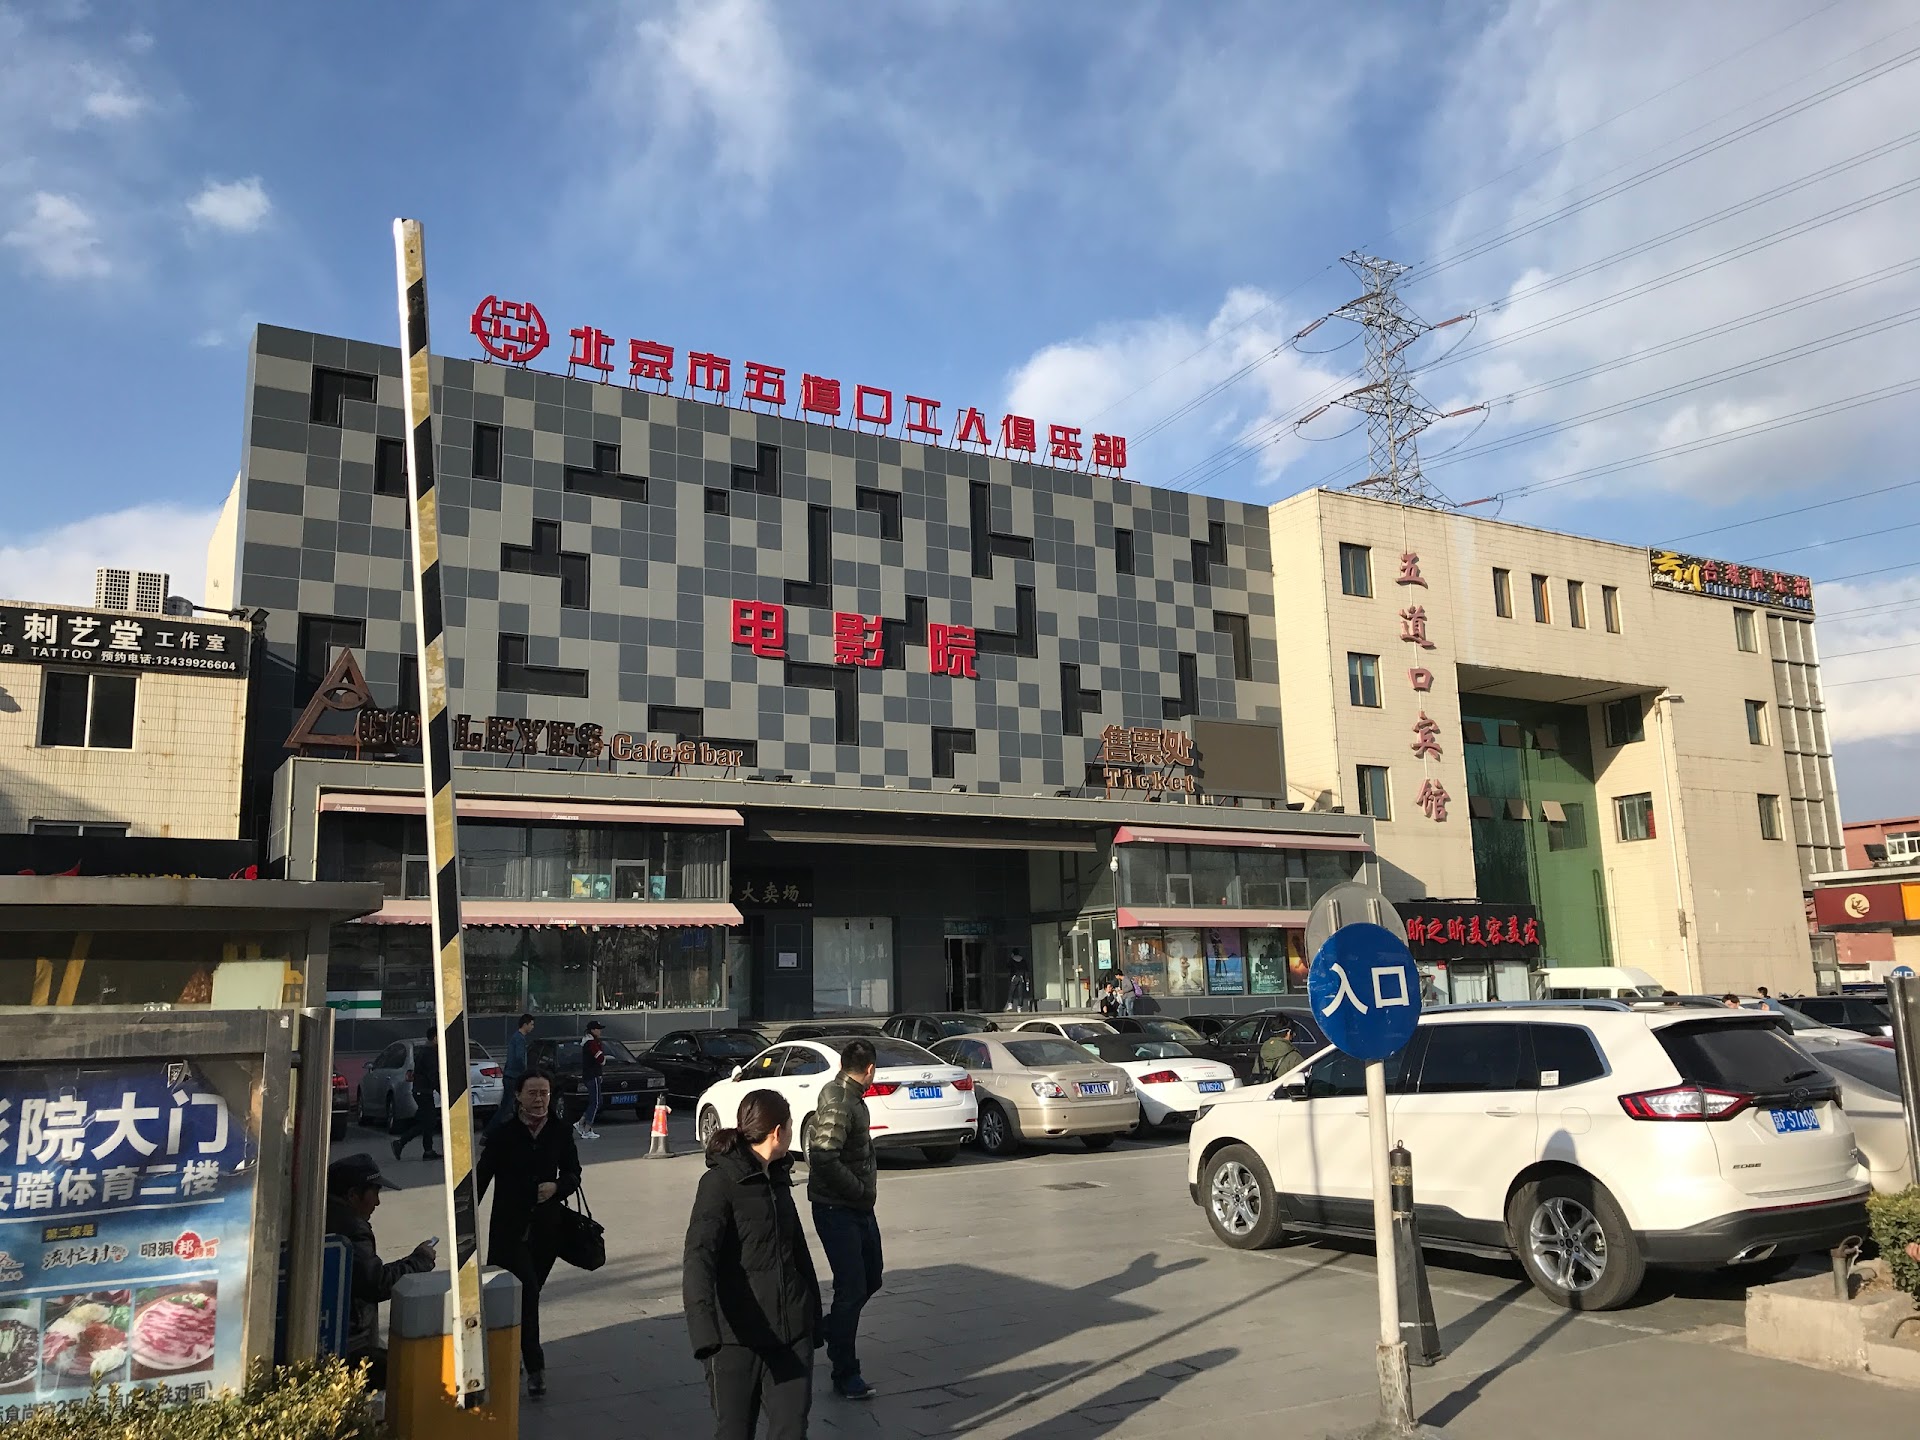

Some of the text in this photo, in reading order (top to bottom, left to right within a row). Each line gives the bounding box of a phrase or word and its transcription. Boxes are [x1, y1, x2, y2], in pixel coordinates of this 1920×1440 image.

[569, 325, 1128, 468] 北京市五道口工人俱乐部
[31, 646, 92, 660] TATTOO
[154, 631, 227, 652] 工作室
[731, 600, 978, 678] 电影院
[1395, 552, 1451, 822] 五道口宾馆
[356, 708, 604, 758] COLEYES
[1103, 724, 1194, 767] 售票处
[1103, 767, 1196, 793] Ticket
[1322, 962, 1410, 1018] 入口
[0, 1090, 229, 1165] 院大门
